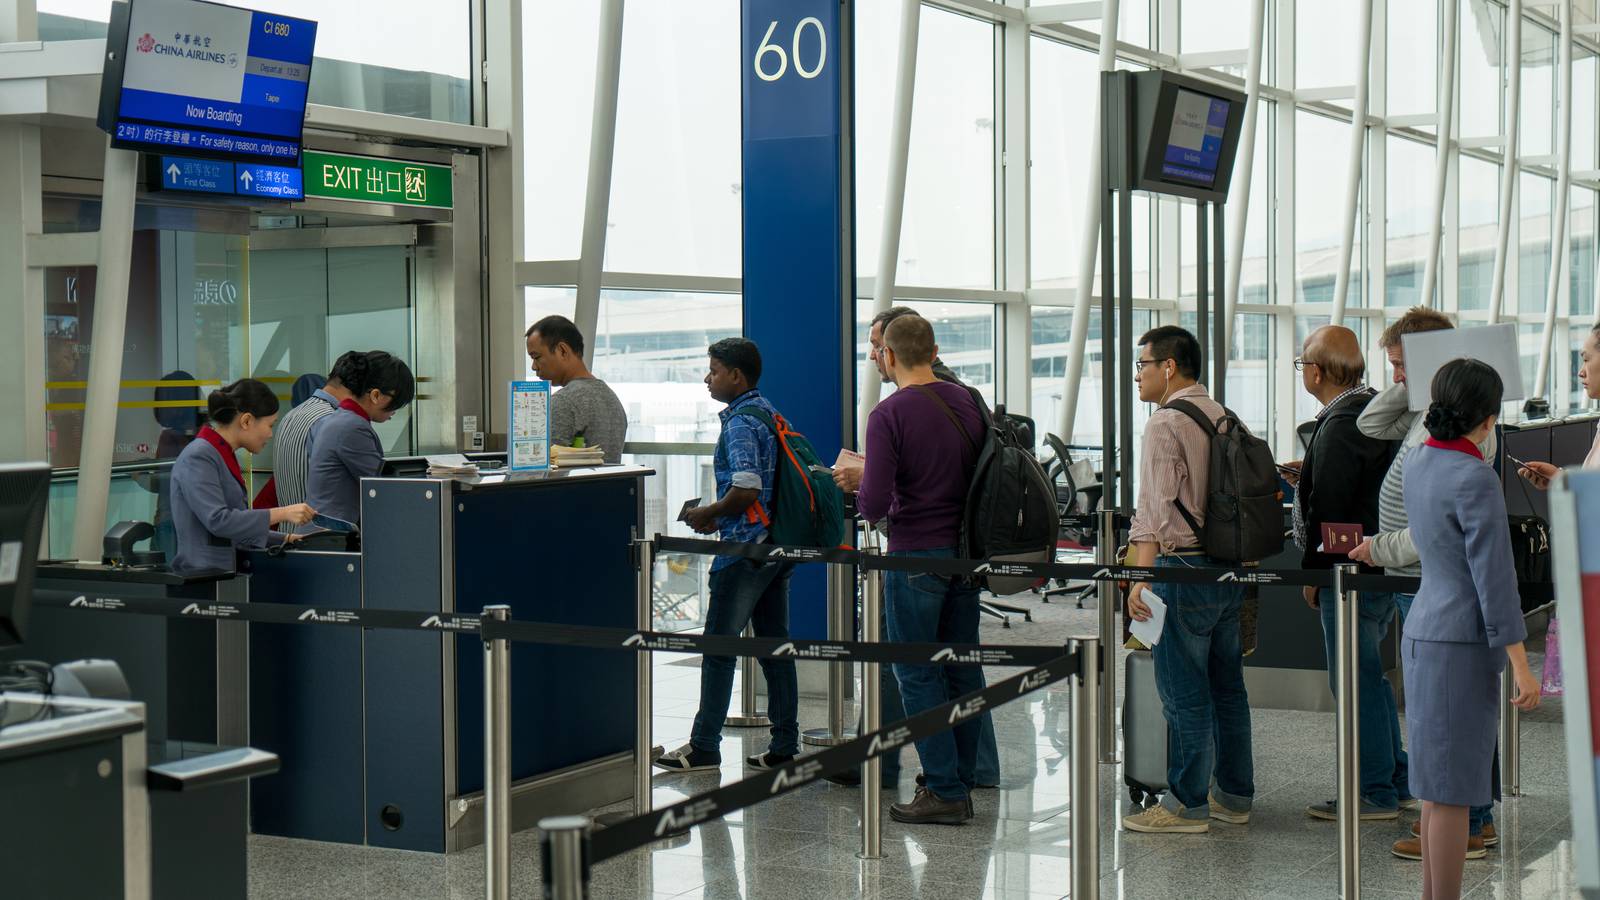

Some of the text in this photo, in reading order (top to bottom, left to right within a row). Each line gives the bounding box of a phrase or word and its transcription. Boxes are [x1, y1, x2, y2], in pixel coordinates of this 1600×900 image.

[264, 20, 290, 37] CI 680
[174, 32, 212, 48] 中華航空
[754, 16, 827, 82] 60
[154, 43, 226, 64] CHINA AIRLINES
[186, 104, 243, 126] Now Boarding
[200, 135, 211, 146] For
[213, 137, 234, 151] safety
[235, 141, 258, 152] reason,
[261, 143, 275, 155] only
[275, 146, 288, 155] one
[199, 179, 216, 189] Class
[323, 164, 401, 194] EXIT 出口
[256, 183, 299, 196] Economy Class
